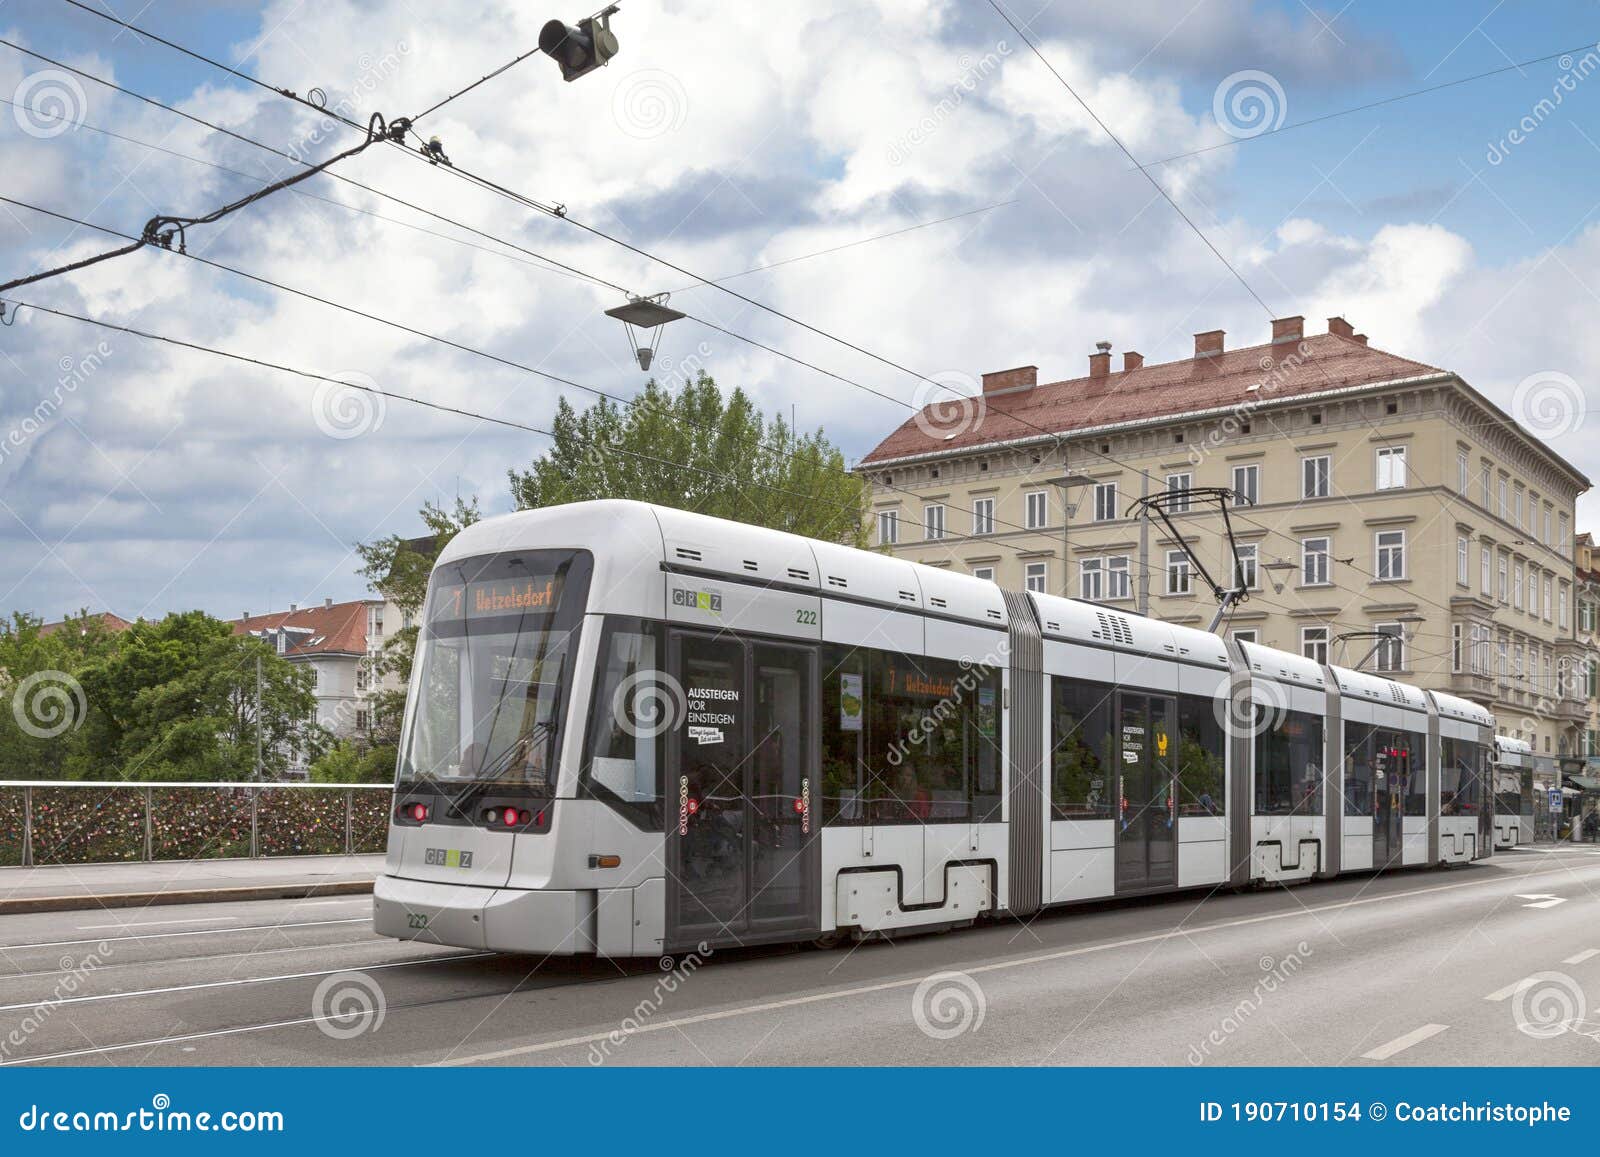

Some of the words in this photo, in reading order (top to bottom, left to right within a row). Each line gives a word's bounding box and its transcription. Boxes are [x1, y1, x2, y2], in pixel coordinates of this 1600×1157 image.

[796, 609, 817, 625] 222
[688, 687, 739, 701] AUSSTEIGEN
[688, 699, 706, 711] VOR
[688, 712, 735, 724] EINSTEIGEN
